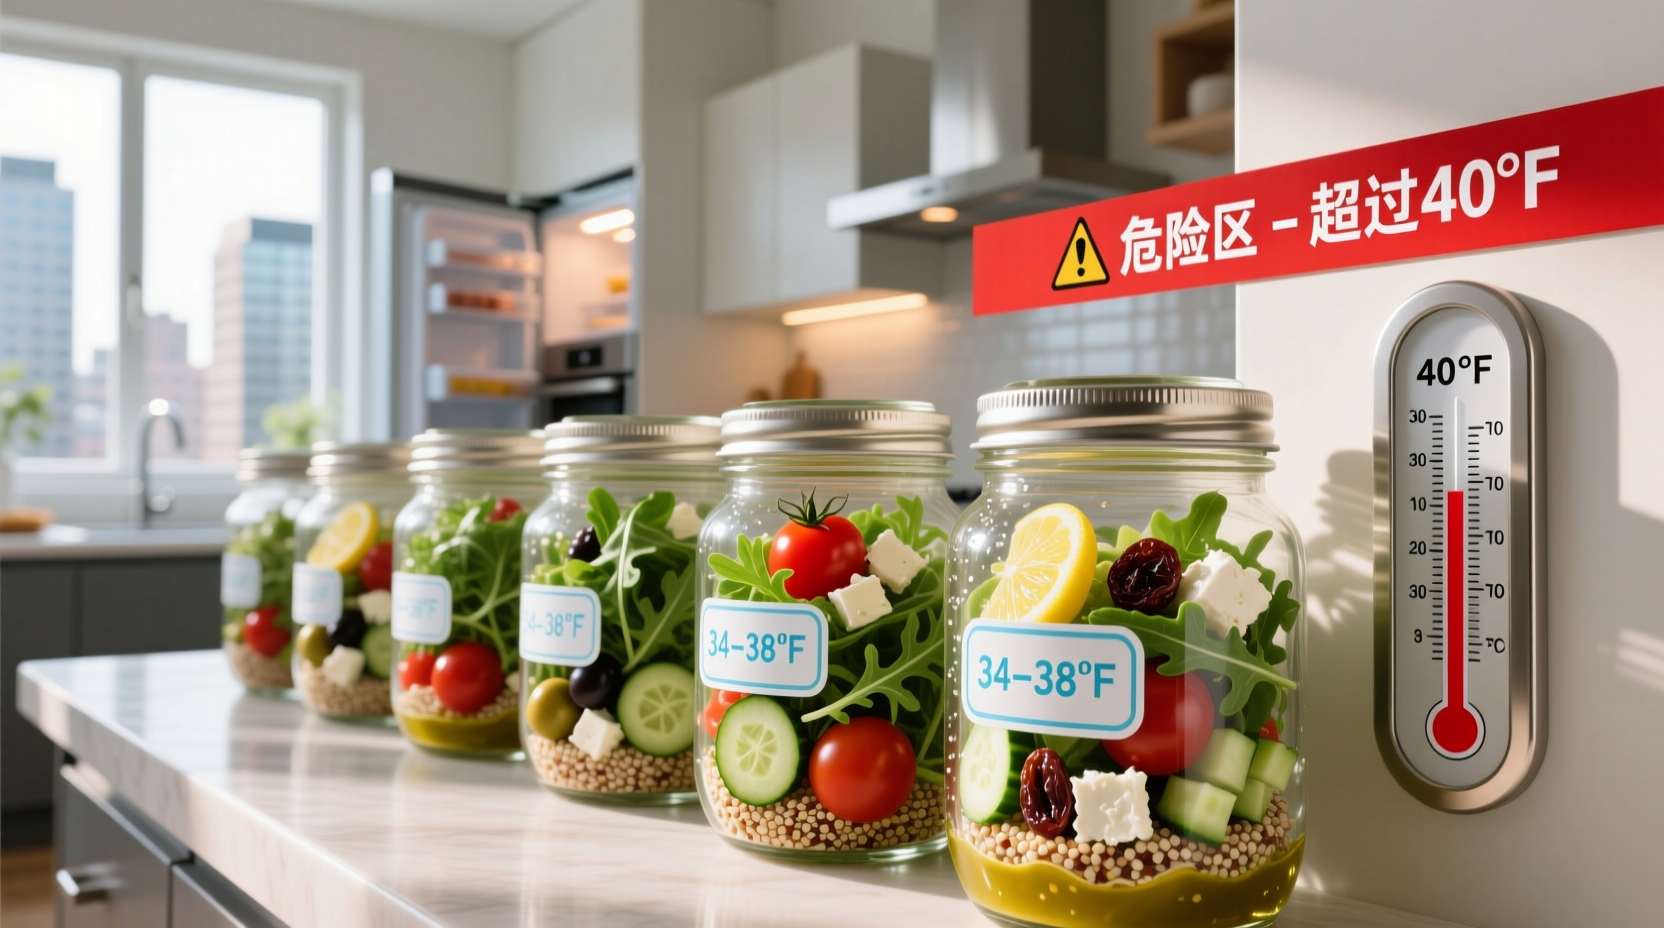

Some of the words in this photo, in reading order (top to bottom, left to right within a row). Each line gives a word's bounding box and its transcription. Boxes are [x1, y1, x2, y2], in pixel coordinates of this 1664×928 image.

[1119, 198, 1258, 276] 危险区
[1309, 145, 1561, 248] 超过40°F
[1416, 354, 1493, 386] 40°F
[1409, 409, 1427, 424] 30
[1408, 453, 1427, 467] 30
[1408, 541, 1427, 555] 20
[1408, 584, 1427, 599] 30
